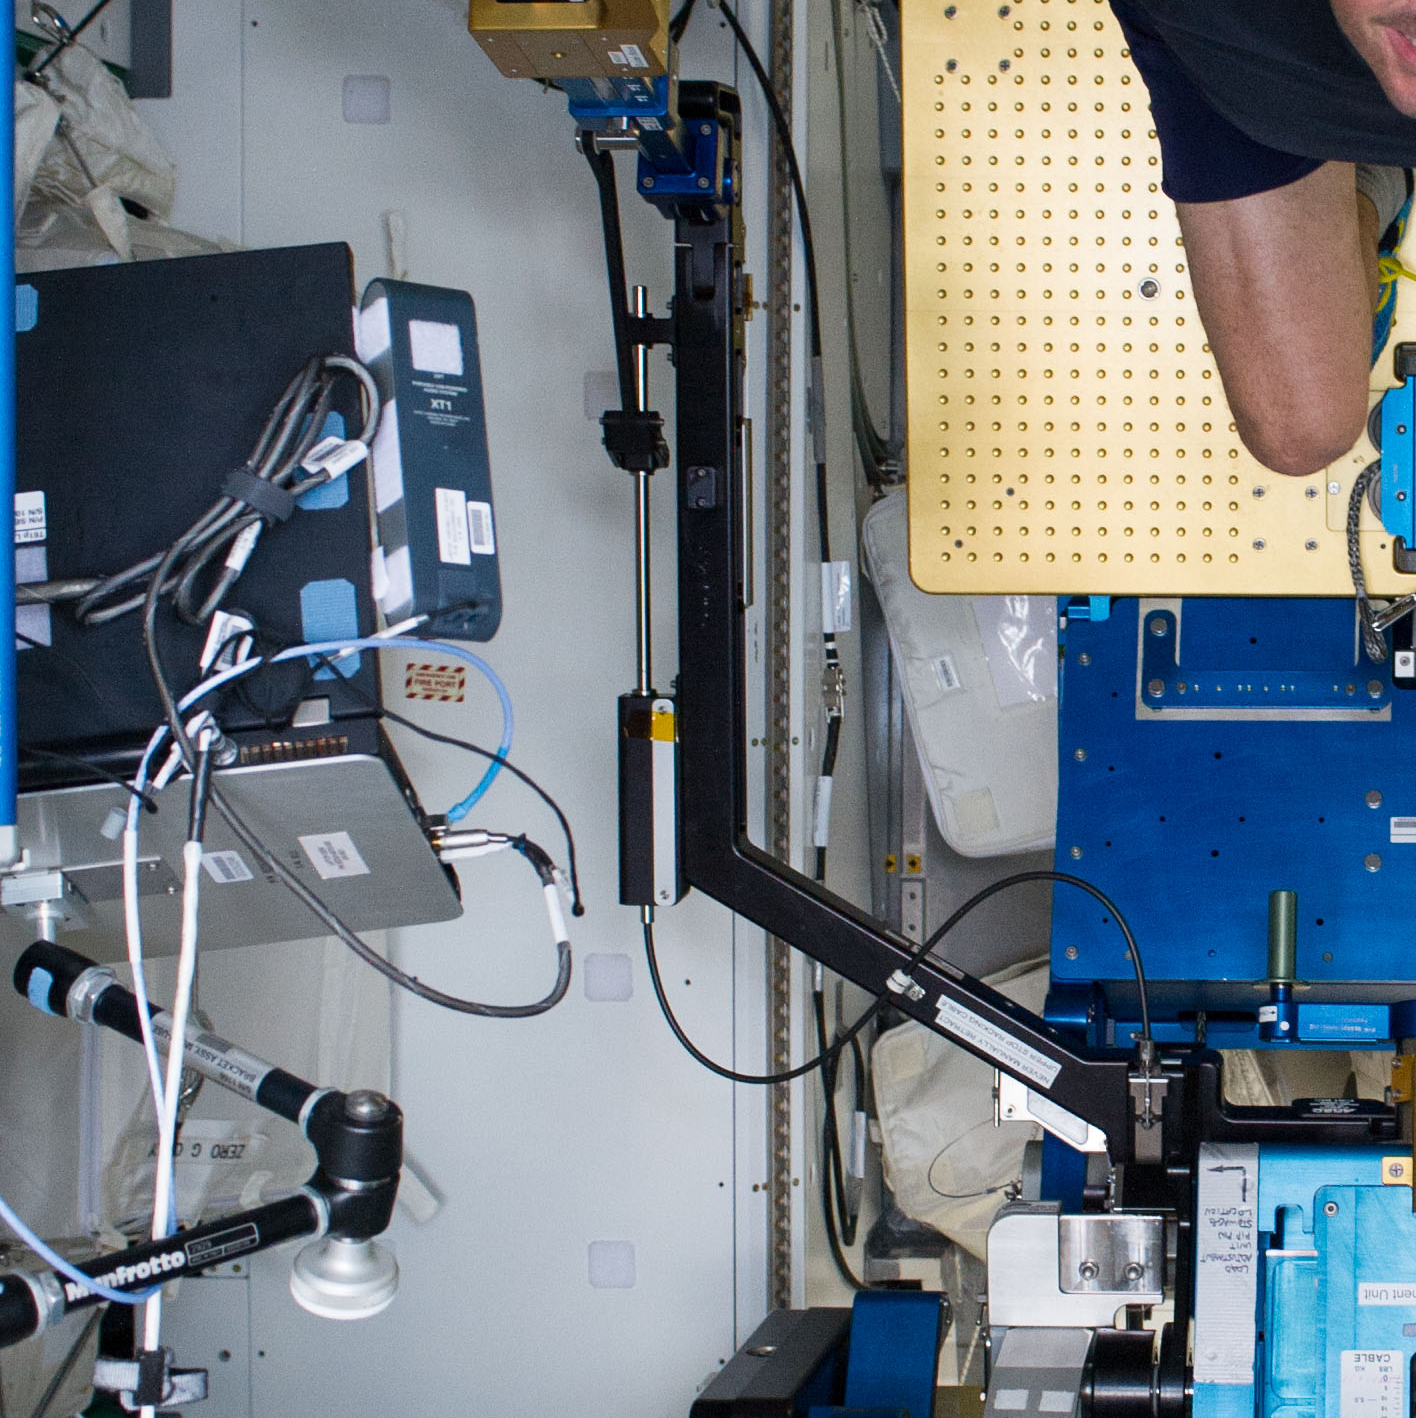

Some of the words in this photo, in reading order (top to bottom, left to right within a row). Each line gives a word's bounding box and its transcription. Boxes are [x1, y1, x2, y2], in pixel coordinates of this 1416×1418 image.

[430, 398, 452, 411] XT1
[939, 999, 969, 1022] CABLE
[938, 1014, 977, 1044] RETRACT
[978, 1038, 1021, 1070] MANUALLY
[1004, 1040, 1029, 1058] STOP
[217, 1058, 257, 1083] BRACKET
[1030, 1052, 1059, 1072] UPPER
[1021, 1062, 1051, 1084] NEVER
[190, 1142, 202, 1158] G
[210, 1143, 245, 1160] ZERO
[1224, 1264, 1249, 1274] LOAD
[1363, 1289, 1390, 1301] Unit
[1353, 1353, 1391, 1363] CABLE
